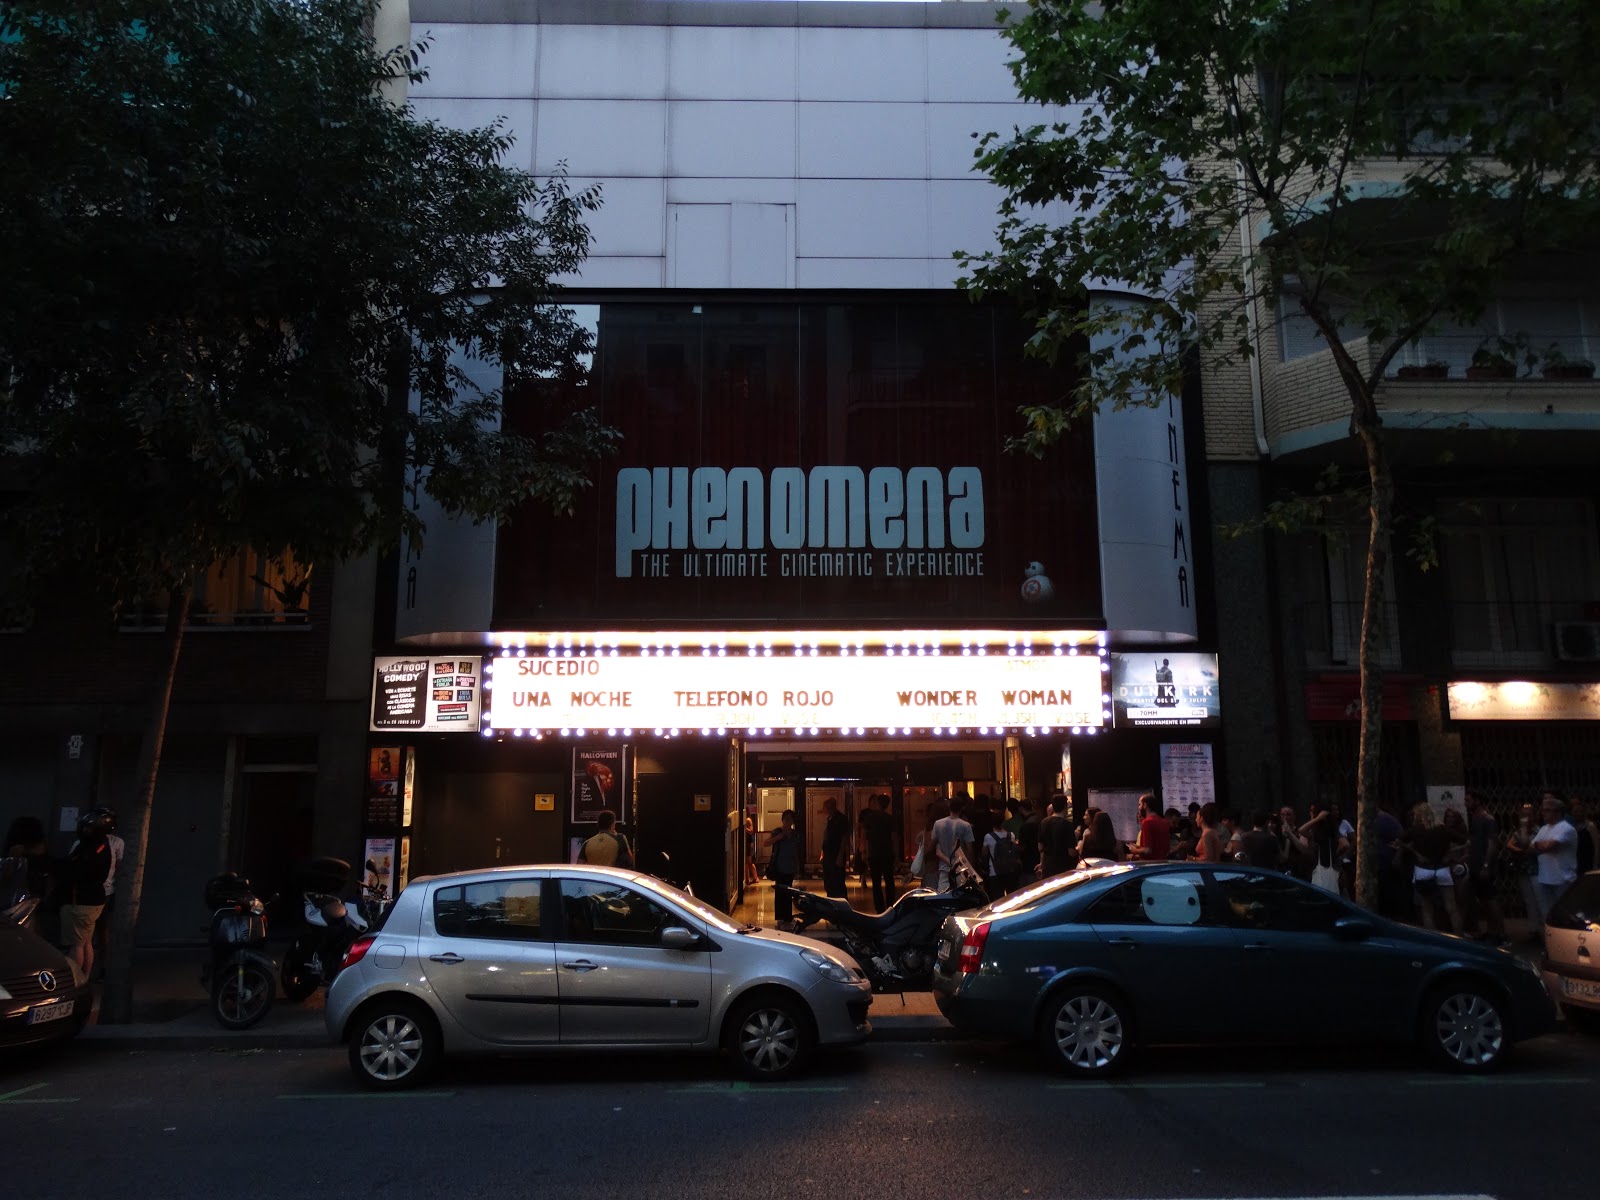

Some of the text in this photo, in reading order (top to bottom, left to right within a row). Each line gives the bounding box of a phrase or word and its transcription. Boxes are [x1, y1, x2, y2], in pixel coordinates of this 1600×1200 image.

[641, 552, 984, 577] THE ULTIMATE CINEMATIC EXPERIENCE
[378, 663, 427, 673] HOLLYWOOD
[518, 660, 600, 676] SUCEDIO
[383, 673, 420, 683] COMEDY
[673, 690, 834, 707] TELEFONO ROJO
[896, 689, 1072, 707] WONDER WOMAN
[1119, 685, 1213, 697] DUNKIRK
[512, 691, 632, 708] UNA NOCHE
